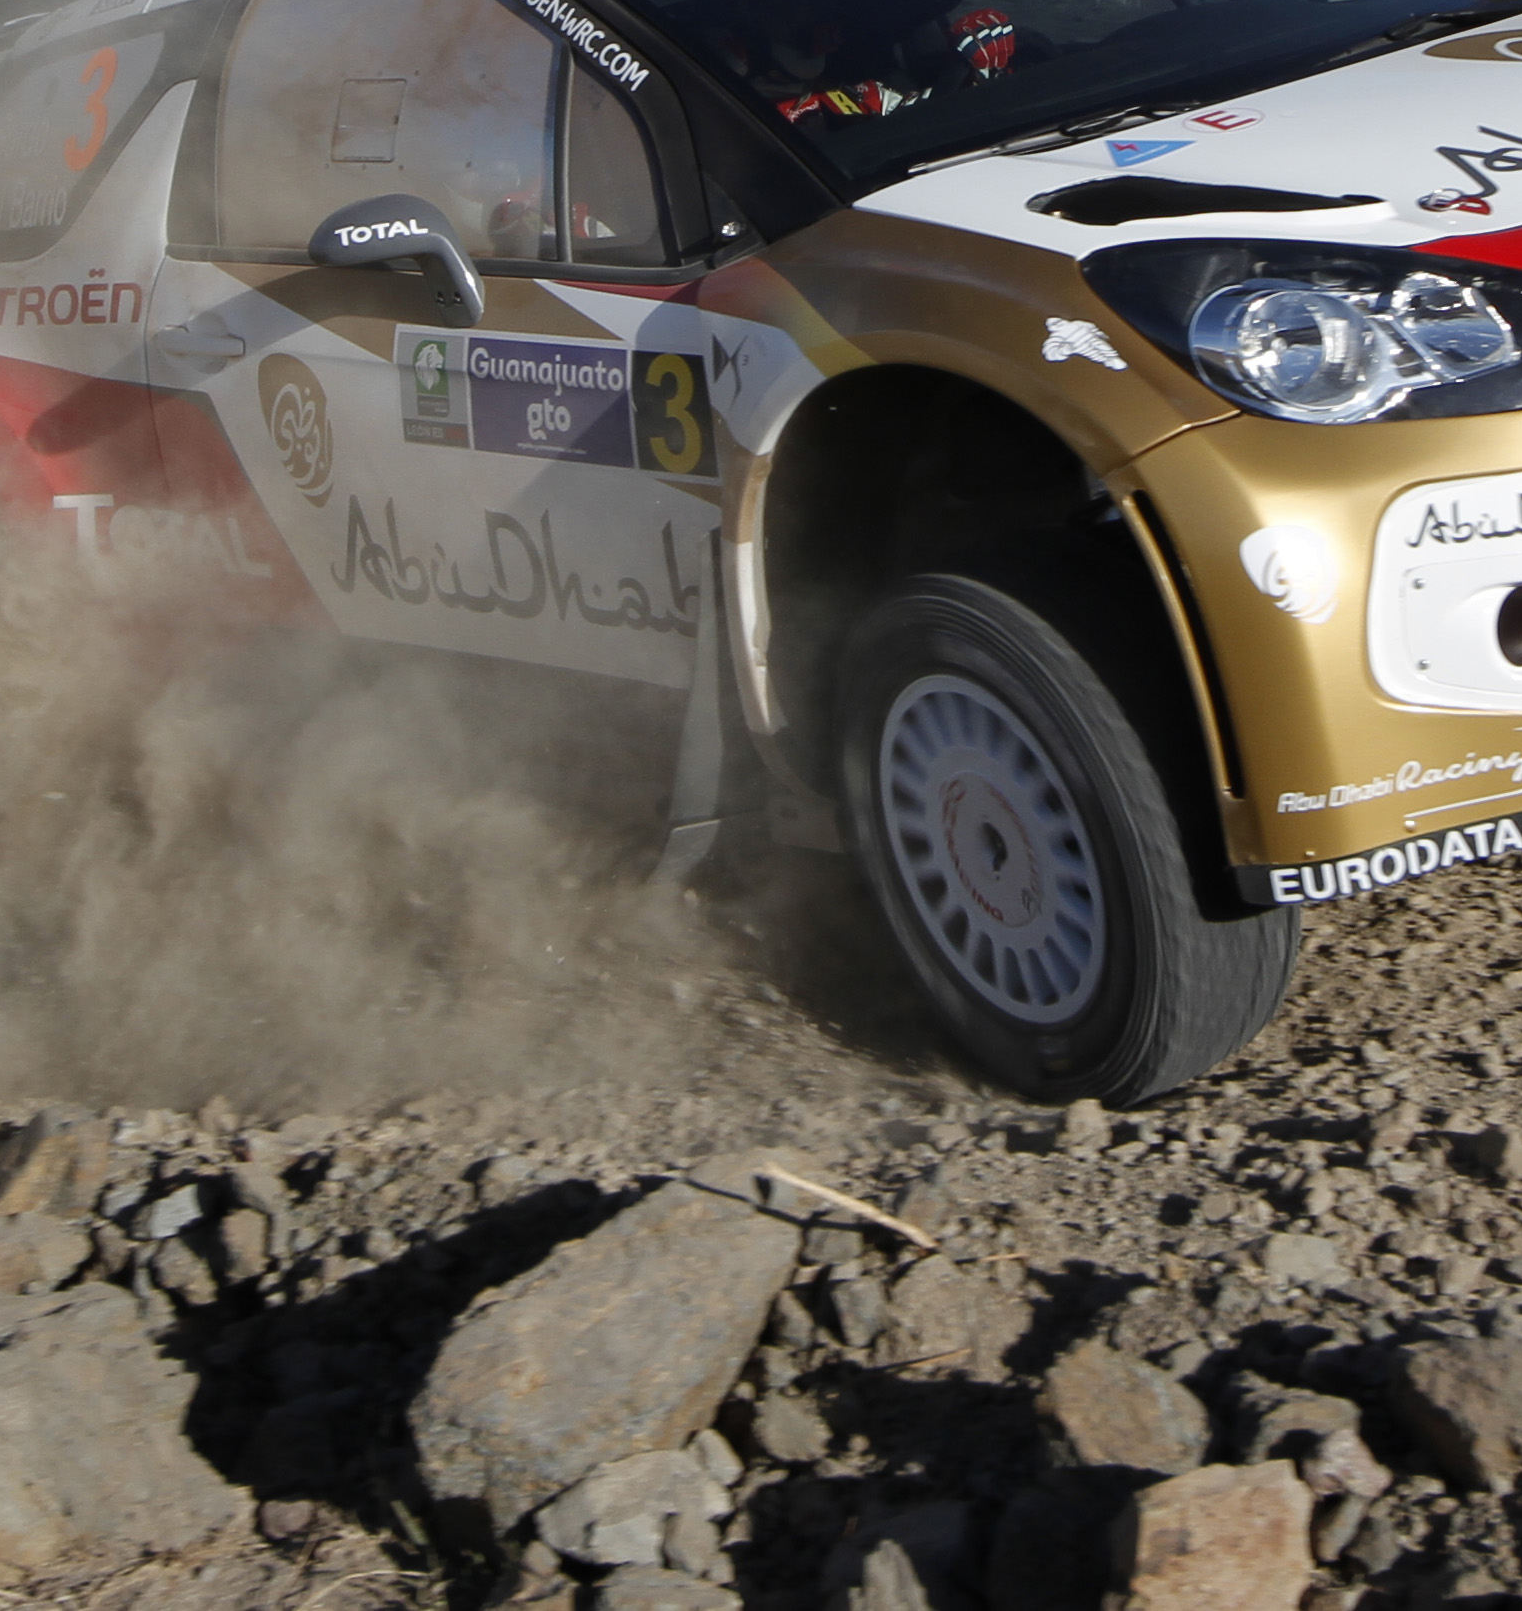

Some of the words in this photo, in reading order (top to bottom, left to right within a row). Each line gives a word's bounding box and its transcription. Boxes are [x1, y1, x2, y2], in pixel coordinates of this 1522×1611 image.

[64, 47, 117, 171] 3
[334, 219, 429, 246] TOTAL
[470, 347, 624, 396] Guanajuato
[527, 399, 572, 442] gto
[645, 352, 702, 474] 3
[1277, 791, 1325, 813] Abu
[1328, 773, 1394, 808] Dhabi
